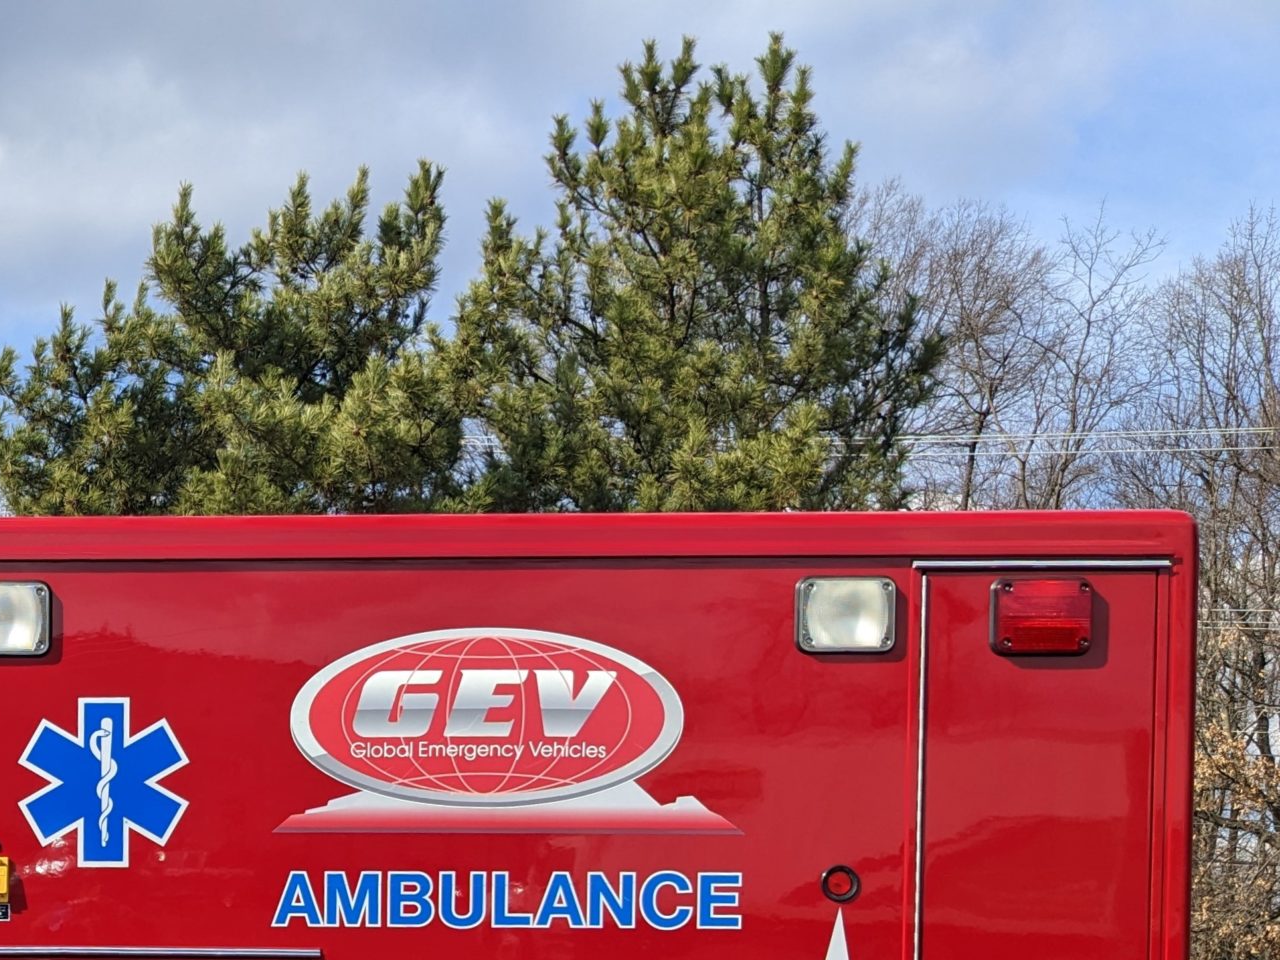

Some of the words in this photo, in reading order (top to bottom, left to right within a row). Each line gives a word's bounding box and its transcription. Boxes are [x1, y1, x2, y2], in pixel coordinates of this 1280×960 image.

[352, 669, 617, 738] GEV
[350, 741, 412, 759] Global
[418, 741, 524, 761] Emergency
[529, 740, 606, 759] Vehicles
[271, 869, 743, 931] AMBULANCE
